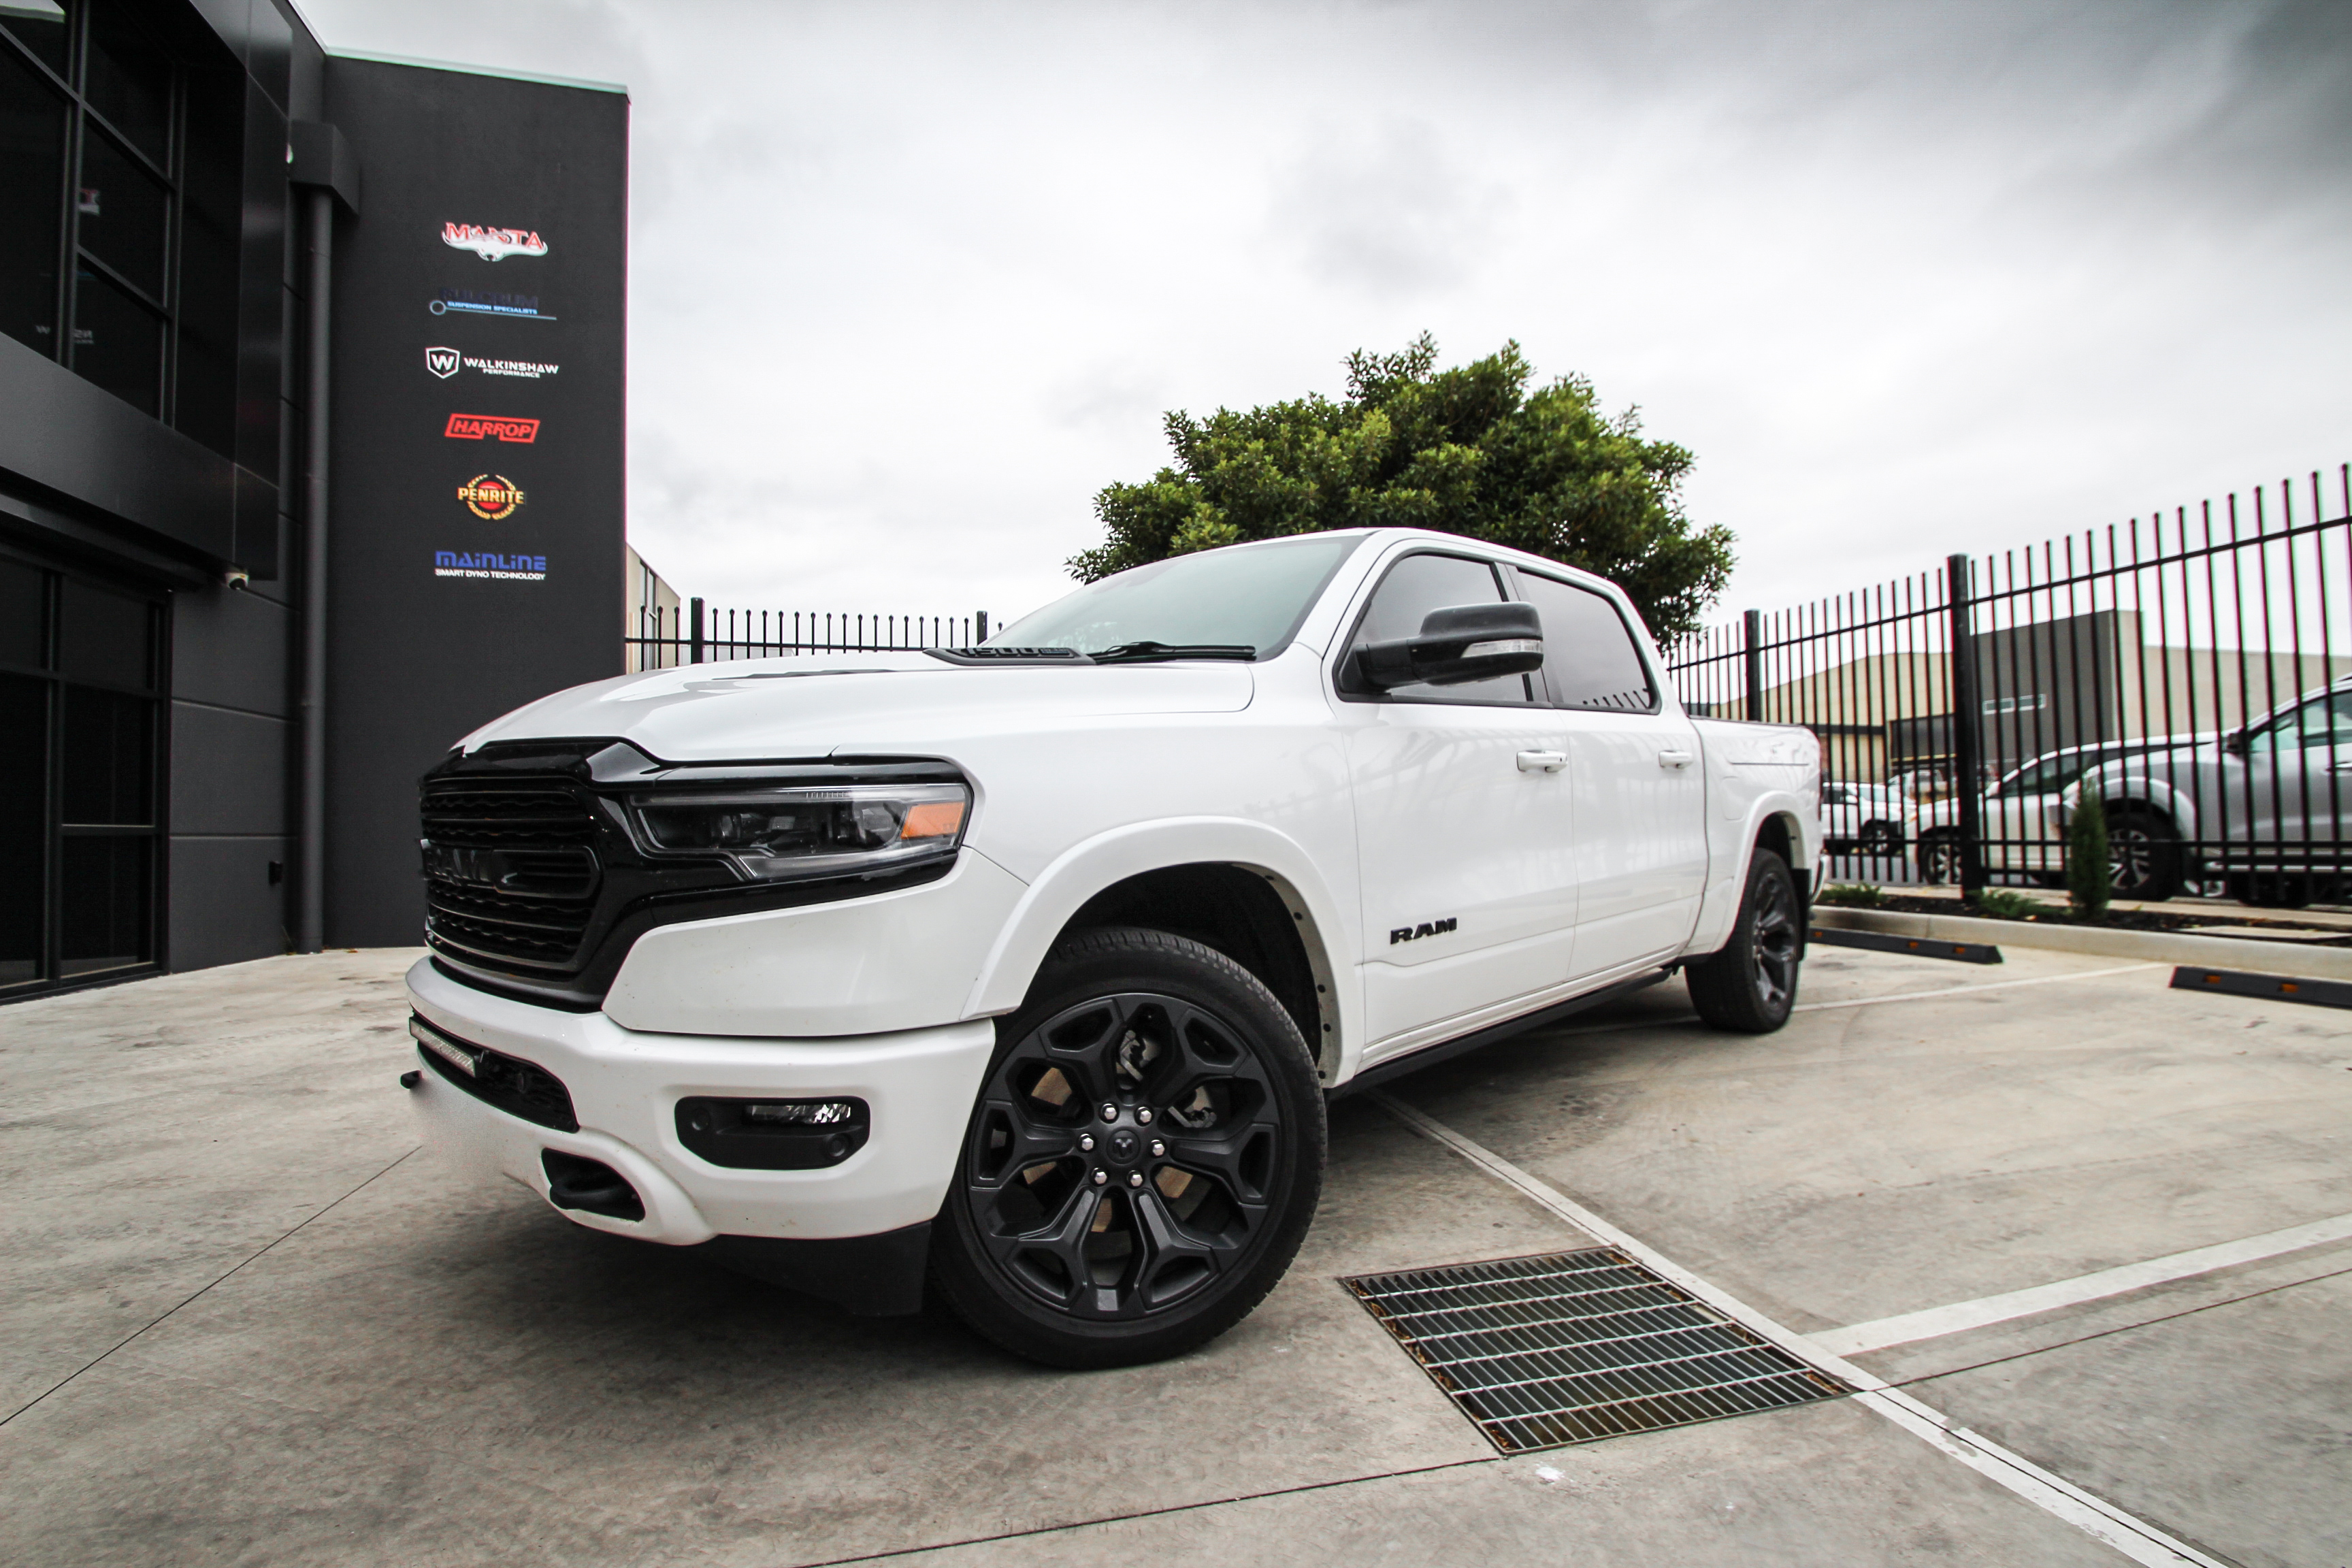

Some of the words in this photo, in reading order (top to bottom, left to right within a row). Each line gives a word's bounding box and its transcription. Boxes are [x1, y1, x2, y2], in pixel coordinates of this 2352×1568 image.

[444, 222, 544, 250] MANTA
[447, 301, 491, 310] SUSPENSION
[493, 305, 538, 314] SPECIALISTS
[463, 357, 559, 374] WALKINSHAW
[483, 368, 540, 378] PERFORMANCE
[454, 420, 532, 437] HARROP
[457, 487, 524, 504] PENRITE
[435, 568, 464, 577] SMART
[466, 570, 489, 578] DYNO
[491, 570, 545, 581] TECHNOLOGY
[1390, 917, 1457, 945] RAM
